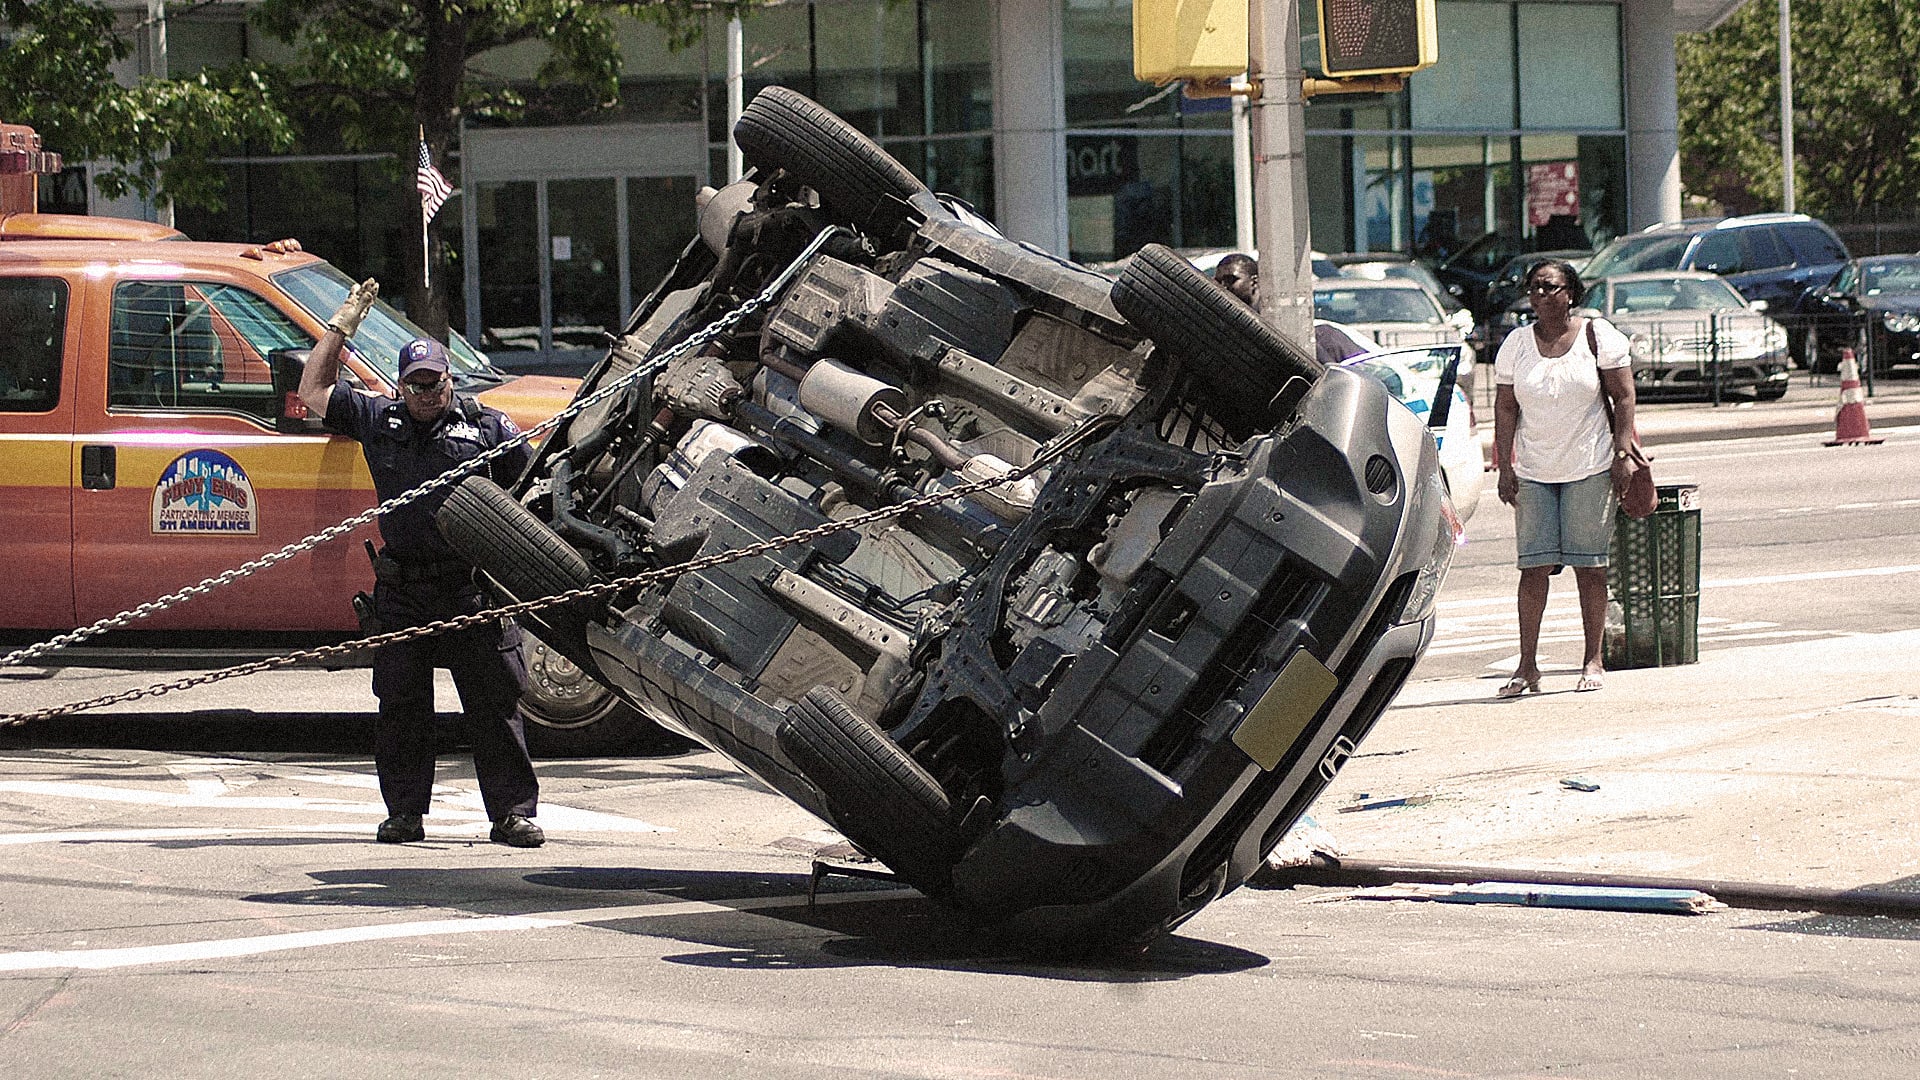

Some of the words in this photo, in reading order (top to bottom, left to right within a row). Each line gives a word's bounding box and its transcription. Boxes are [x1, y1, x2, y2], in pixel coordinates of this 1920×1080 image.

[162, 476, 204, 508] FDNY
[211, 477, 248, 509] EMS
[160, 509, 215, 520] PARTICIPATING
[217, 510, 250, 521] MEMBER
[160, 520, 177, 531] 911
[179, 520, 251, 531] AMBULANCE
